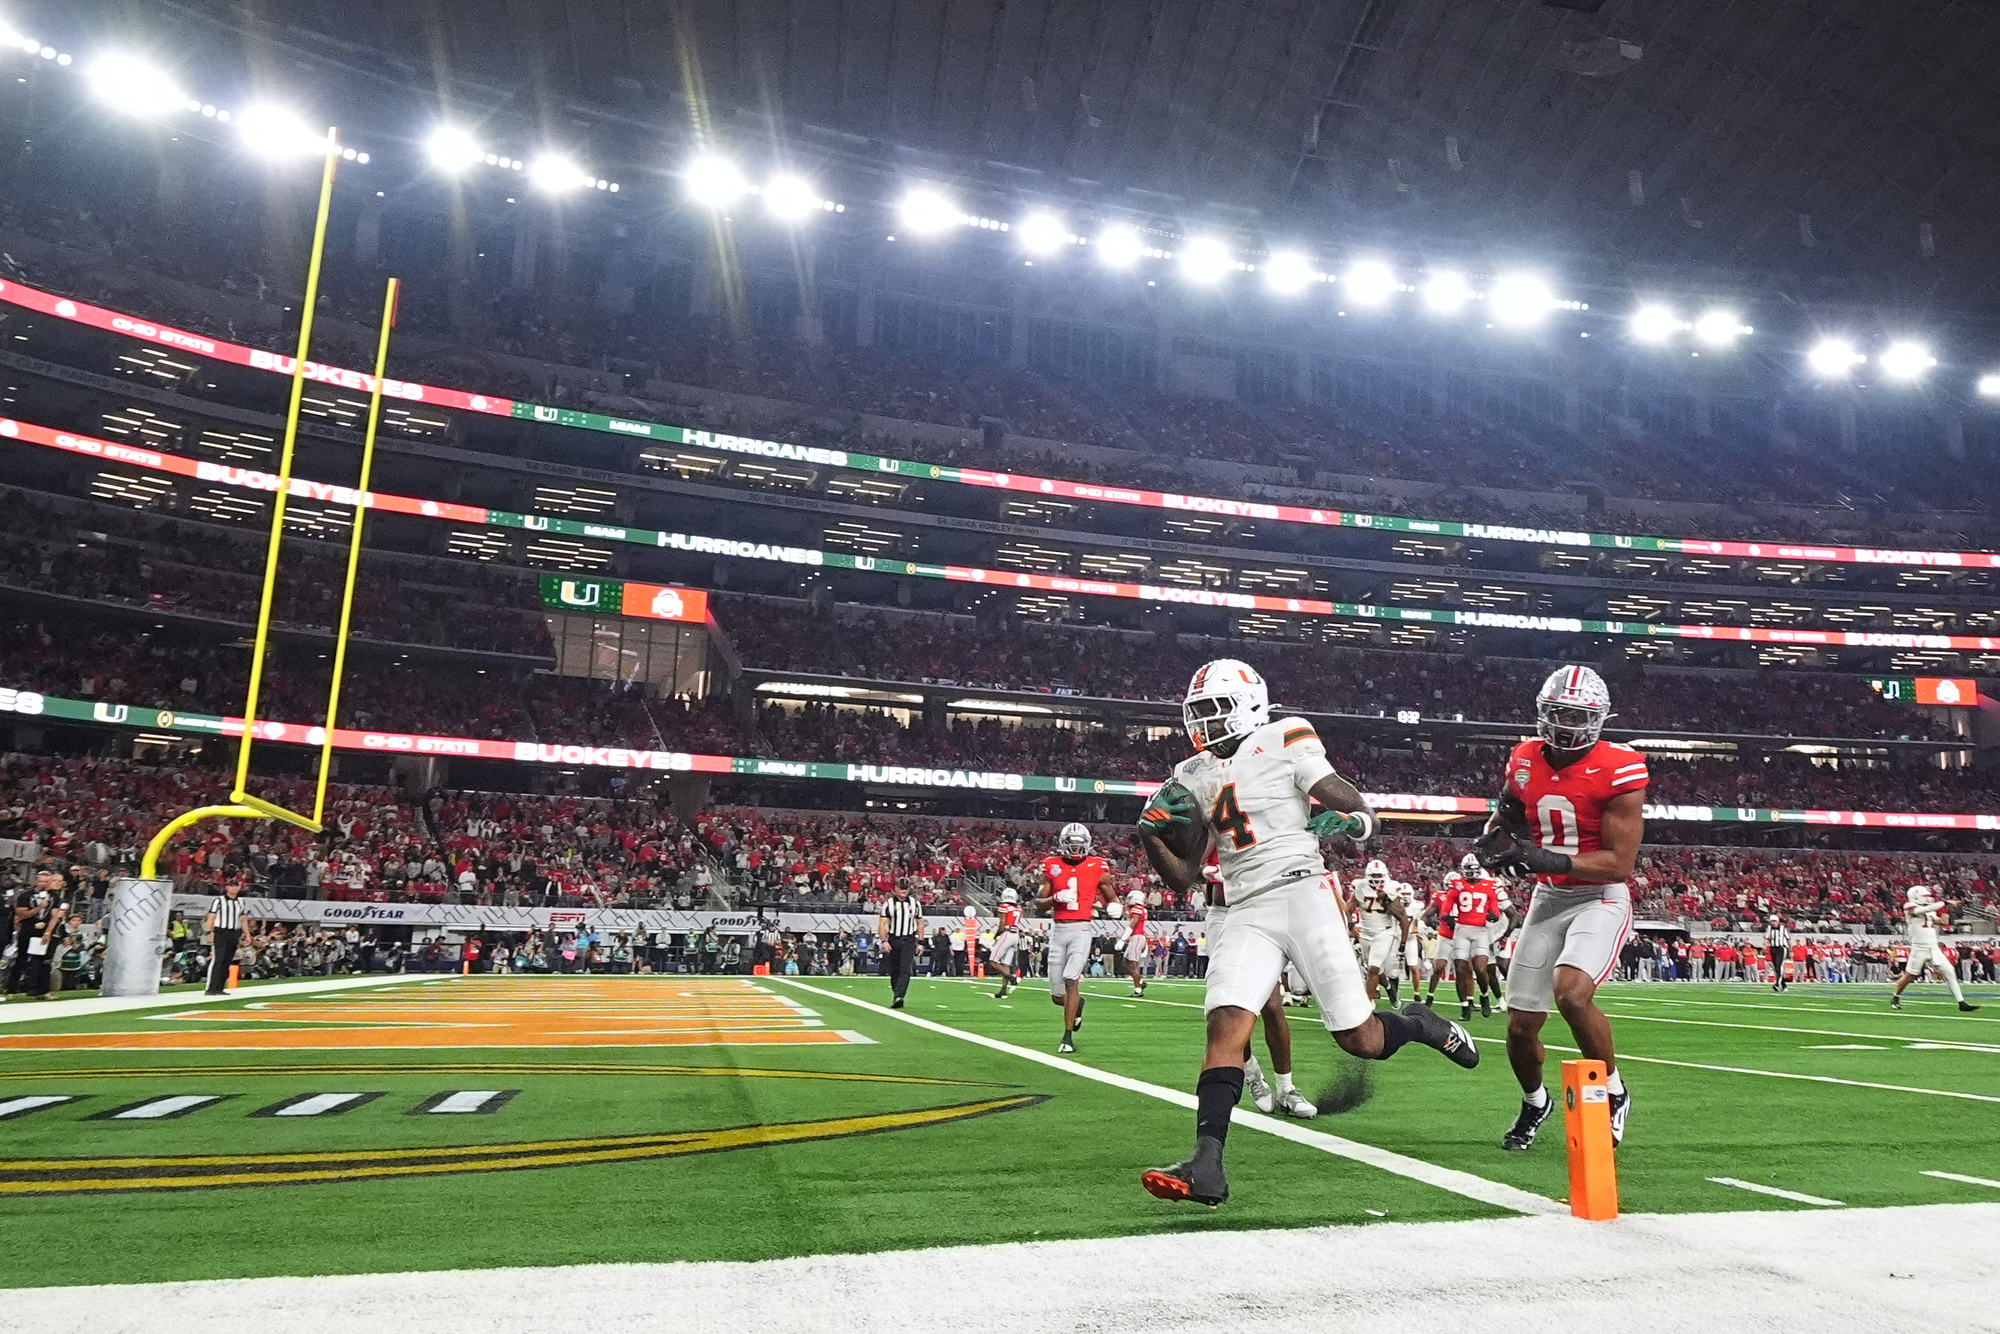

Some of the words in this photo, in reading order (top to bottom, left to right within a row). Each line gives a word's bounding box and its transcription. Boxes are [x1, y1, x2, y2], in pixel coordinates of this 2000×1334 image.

[112, 318, 156, 337] OHIO
[159, 331, 214, 352] STATE
[250, 349, 423, 401] BUCKEYES
[680, 428, 848, 466] HURRICANES
[55, 435, 101, 453] OHIO
[104, 445, 161, 467] STATE
[196, 461, 374, 508] BUCKEYES
[1104, 490, 1140, 502] STATE
[1163, 493, 1279, 519] BUCKEYES
[1463, 523, 1590, 546] HURRICANES
[658, 531, 825, 567] HURRICANES
[1855, 549, 1961, 566] BUCKEYES
[1139, 585, 1255, 609] BUCKEYES
[1455, 611, 1582, 632] HURRICANES
[1845, 632, 1951, 649] BUCKEYES
[363, 735, 413, 749] OHIO
[416, 739, 479, 754] STATE
[514, 742, 692, 771] BUCKEYES
[758, 762, 806, 776] MIAMI
[847, 764, 1023, 790] HURRICANES
[1360, 793, 1458, 811] CKEYES
[1211, 782, 1257, 851] 4
[1536, 795, 1580, 855] 0
[1886, 815, 1916, 825] OHIO
[1917, 816, 1955, 826] STATE
[1066, 876, 1079, 910] 1
[1458, 892, 1488, 913] 97
[324, 907, 404, 919] GOODYEAR
[550, 913, 586, 922] ESPN
[712, 917, 780, 927] GOODYR
